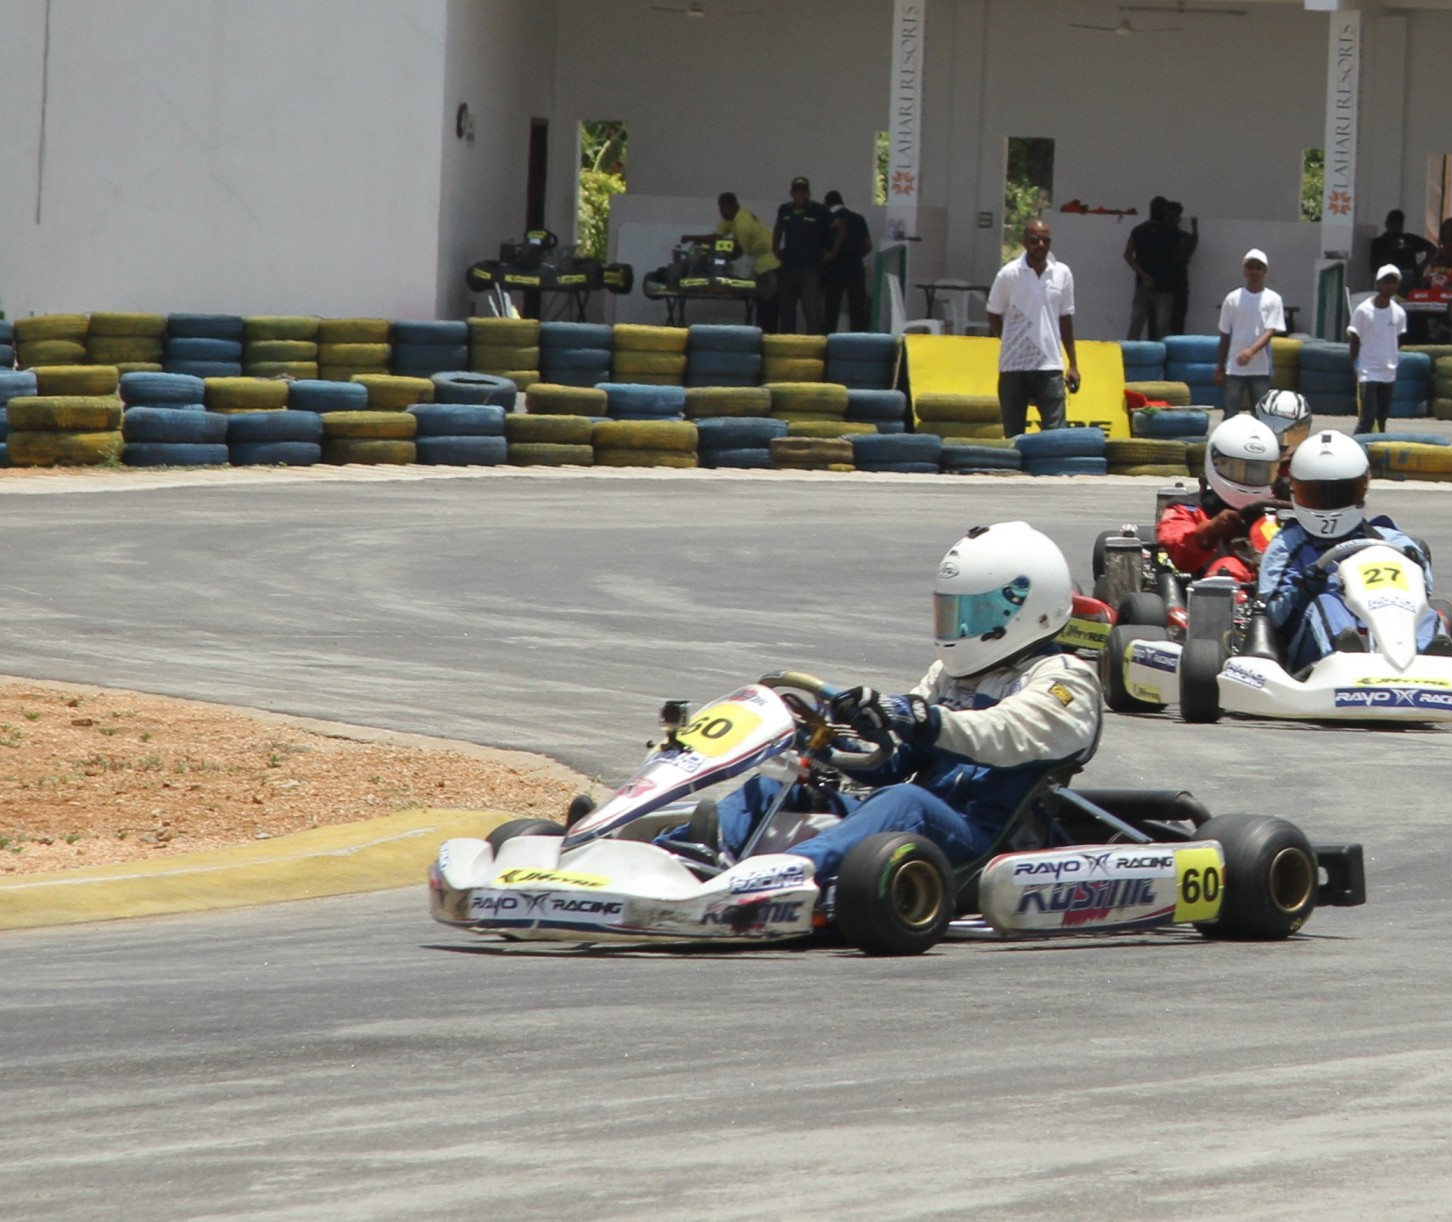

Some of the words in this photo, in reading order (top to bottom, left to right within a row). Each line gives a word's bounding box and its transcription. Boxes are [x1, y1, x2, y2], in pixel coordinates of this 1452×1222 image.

[900, 6, 918, 89] RESORTS
[1336, 24, 1353, 109] RESORTS
[897, 97, 914, 169] LAHARI
[1333, 116, 1350, 188] LAHARI
[1321, 519, 1337, 534] 27
[1363, 567, 1400, 584] 27
[1335, 692, 1390, 706] RAYO
[1014, 860, 1081, 880] RAYO
[1116, 856, 1174, 870] RACING
[1182, 867, 1219, 904] 60
[471, 896, 518, 916] RAYO
[552, 898, 624, 917] RACING
